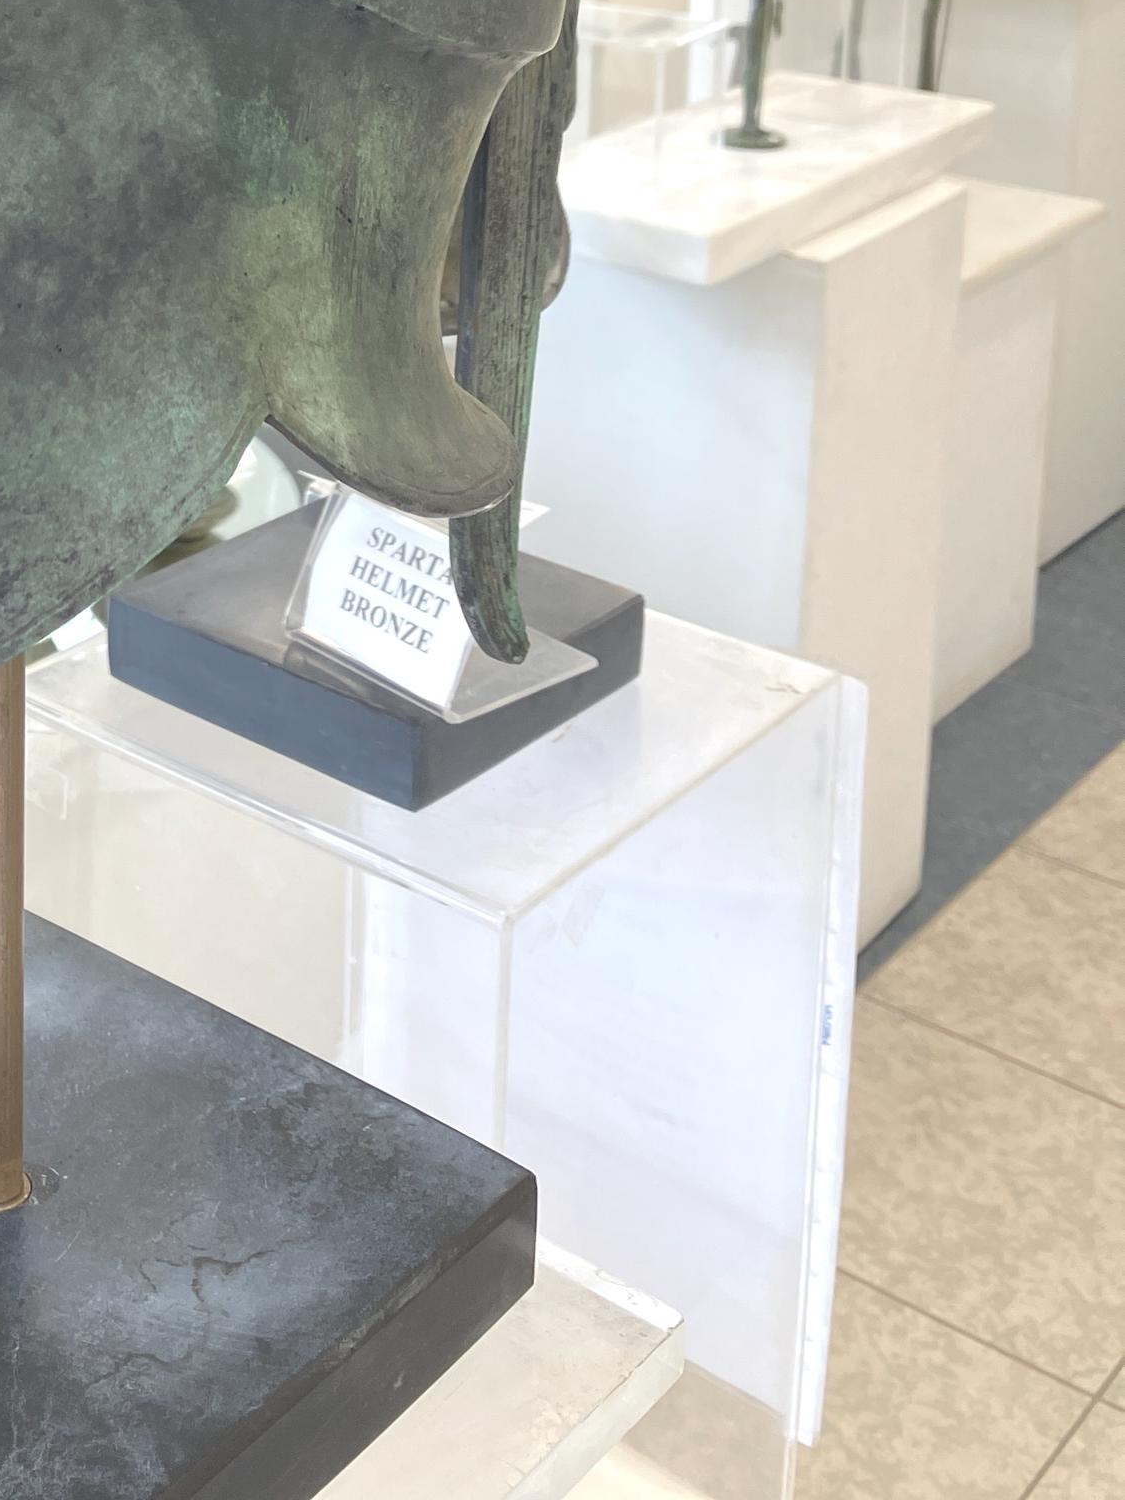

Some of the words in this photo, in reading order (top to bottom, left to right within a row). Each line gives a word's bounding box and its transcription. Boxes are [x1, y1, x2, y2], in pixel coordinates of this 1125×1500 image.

[348, 555, 450, 620] HELMET
[366, 526, 453, 587] SPARTA
[339, 588, 434, 654] BRONZE
